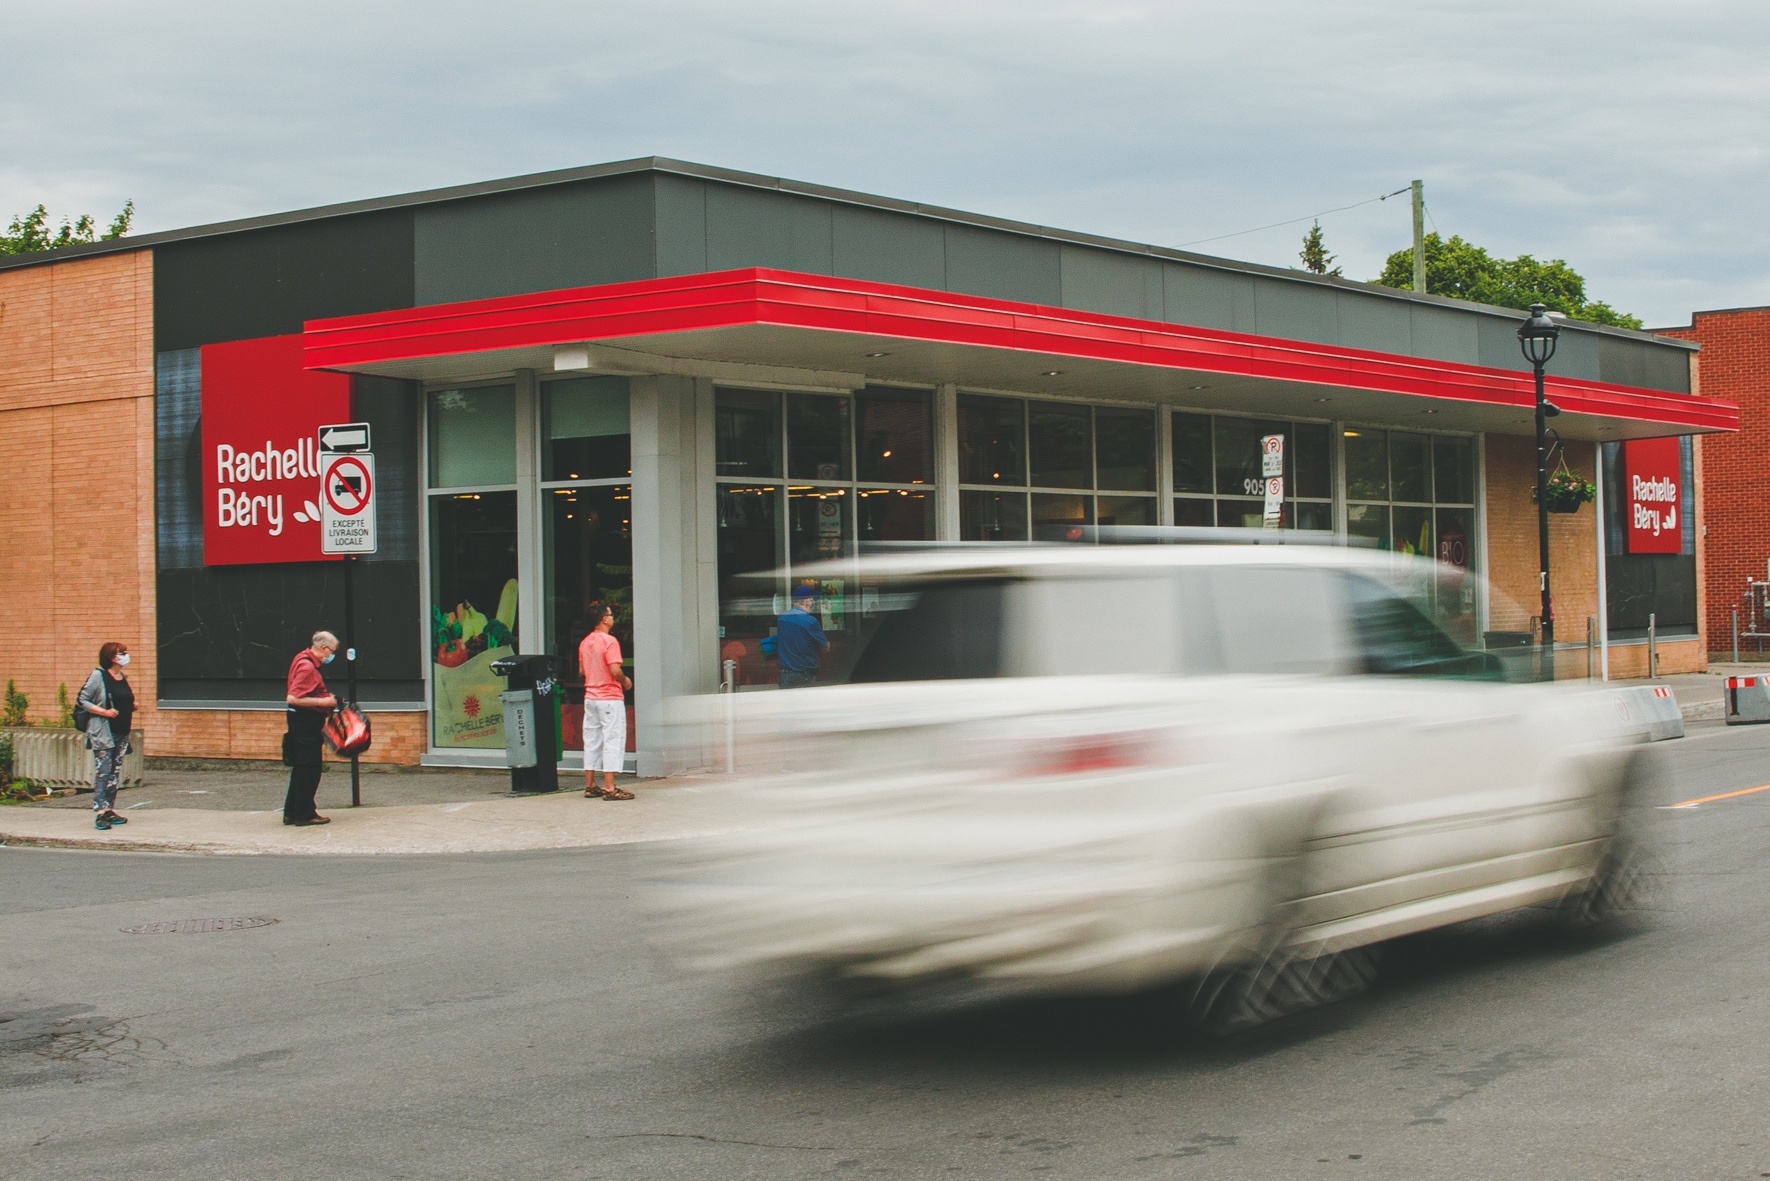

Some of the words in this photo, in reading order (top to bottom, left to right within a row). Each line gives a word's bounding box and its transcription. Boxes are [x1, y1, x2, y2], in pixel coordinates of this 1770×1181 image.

[217, 437, 321, 483] Rachell
[1243, 478, 1265, 495] 905
[1632, 474, 1676, 502] Rachelle
[218, 488, 283, 536] Béry
[1633, 503, 1660, 537] Béry
[329, 528, 369, 537] LIVRAISON
[335, 537, 363, 546] LOCALE
[1441, 541, 1464, 565] BIO
